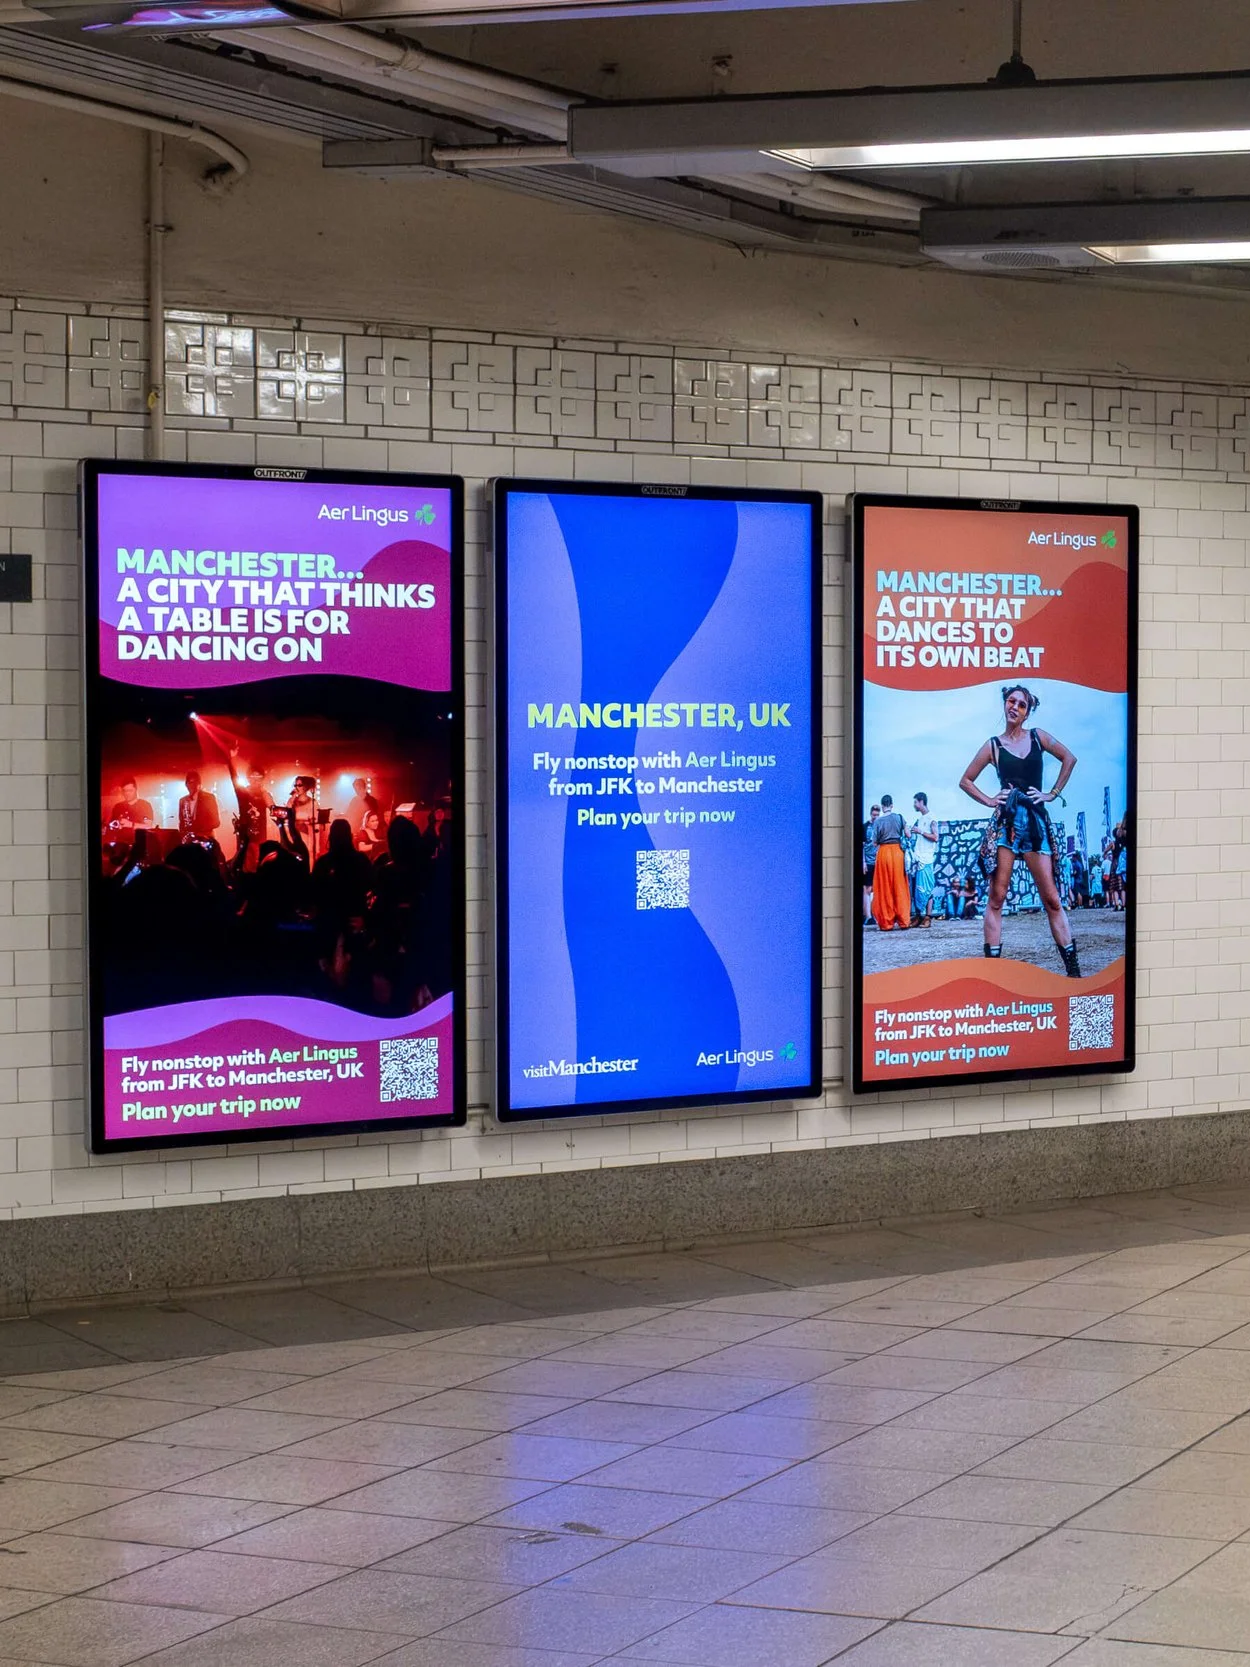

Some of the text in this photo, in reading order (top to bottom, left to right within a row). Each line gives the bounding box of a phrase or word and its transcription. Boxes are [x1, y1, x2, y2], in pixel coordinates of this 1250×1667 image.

[318, 504, 409, 526] Aer Lingus
[1028, 531, 1097, 550] Aer Lingus
[117, 548, 364, 580] MANCHESTER...
[117, 579, 436, 609] A CITY THAT THINKS
[876, 570, 1063, 597] MANCHESTER...
[876, 596, 1026, 620] A CITY THAT
[117, 607, 350, 635] A TABLE IS FOR
[877, 620, 1014, 644] DANCES TO
[118, 635, 322, 662] DANCING ON
[877, 645, 1044, 668] ITS OWN BEAT
[527, 703, 791, 732] MANCHESTER, UK
[533, 750, 777, 775] Fly nonstop with Aer Lingus
[549, 776, 763, 796] from JFK to Manchester
[577, 808, 735, 830] Plan your trip now
[874, 1001, 1053, 1027] Fly nonstop with Aer Lingus
[874, 1016, 1057, 1042] from JFK to Manchester, UK
[121, 1045, 358, 1076] Fly nonstop with Aer Lingus
[523, 1056, 639, 1079] visitManchester
[696, 1049, 774, 1068] Aer Lingus
[875, 1043, 1010, 1068] Plan your trip now
[121, 1062, 364, 1093] from JFK to Manchester, UK
[122, 1094, 302, 1123] Plan your trip now
